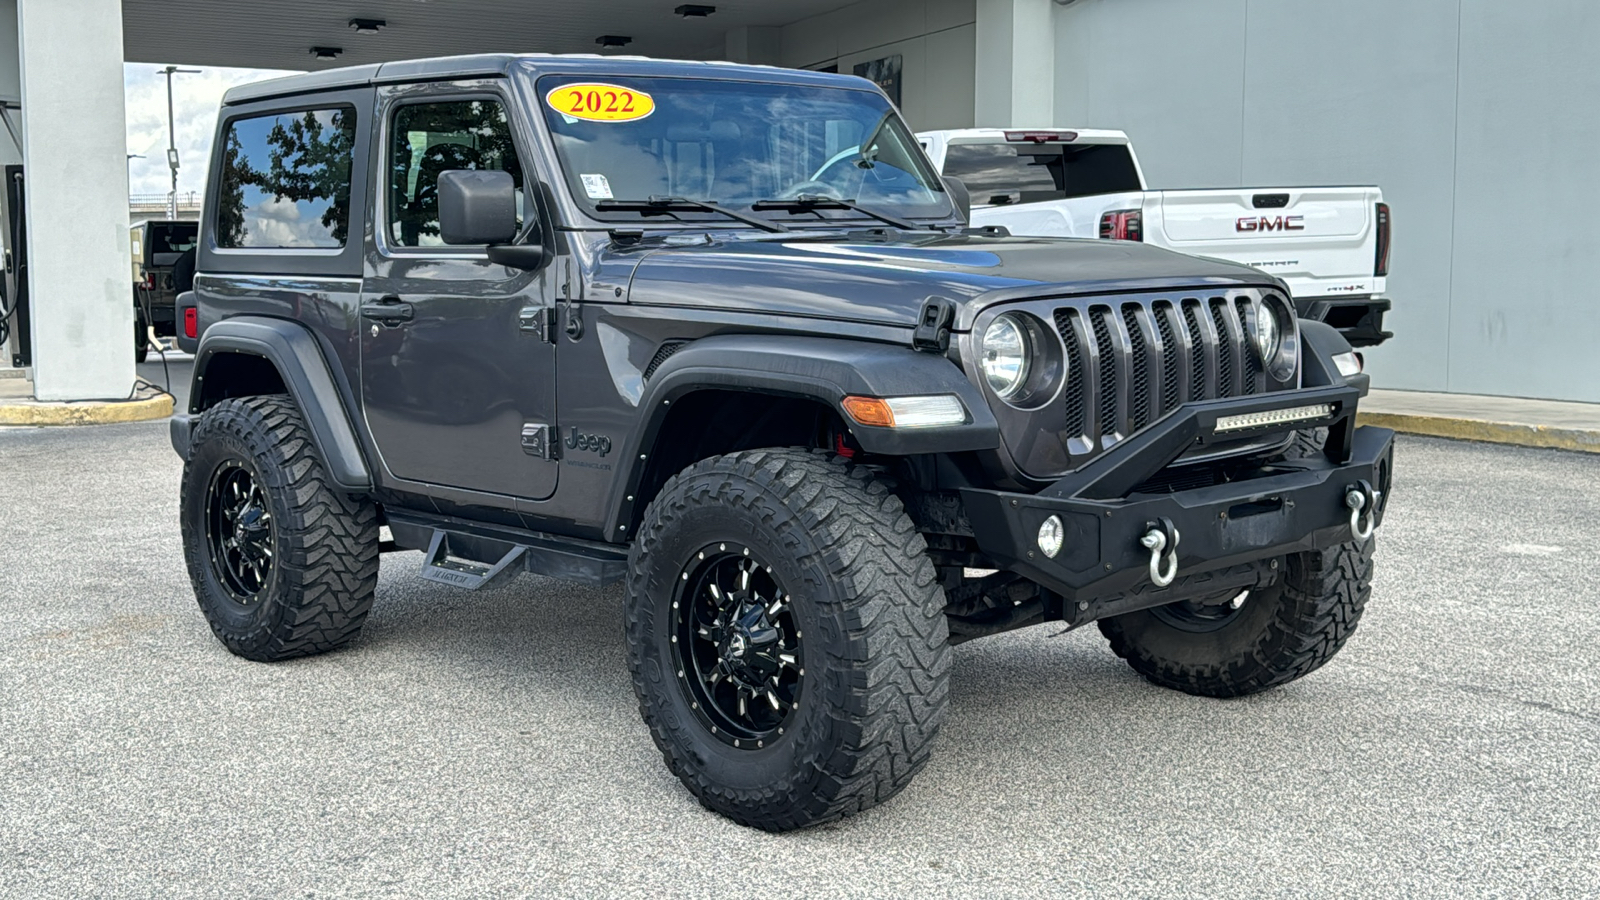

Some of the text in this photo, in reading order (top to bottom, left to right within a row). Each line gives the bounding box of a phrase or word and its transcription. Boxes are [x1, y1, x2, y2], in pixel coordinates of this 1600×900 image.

[568, 90, 635, 113] 2022
[1236, 215, 1304, 232] GMC
[564, 425, 612, 458] Jeep
[567, 460, 612, 471] WRANGLER
